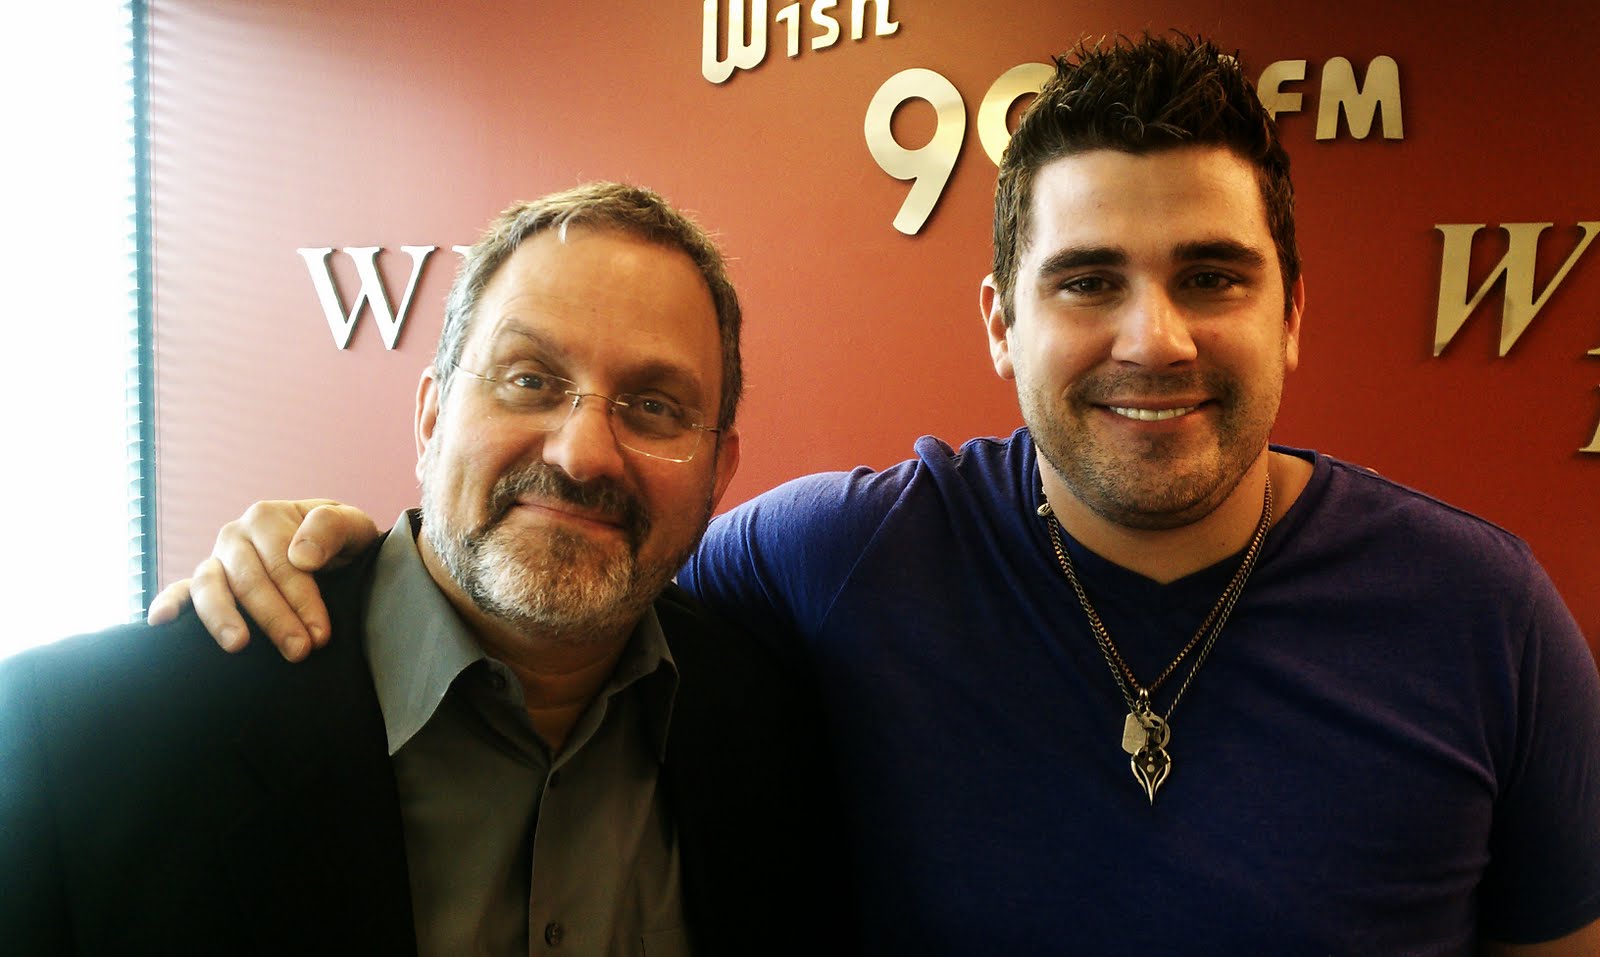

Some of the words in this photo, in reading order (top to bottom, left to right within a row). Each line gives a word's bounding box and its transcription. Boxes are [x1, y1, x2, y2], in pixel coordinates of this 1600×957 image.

[1257, 55, 1404, 140] FM
[296, 245, 474, 351] W
[1432, 221, 1600, 357] W
